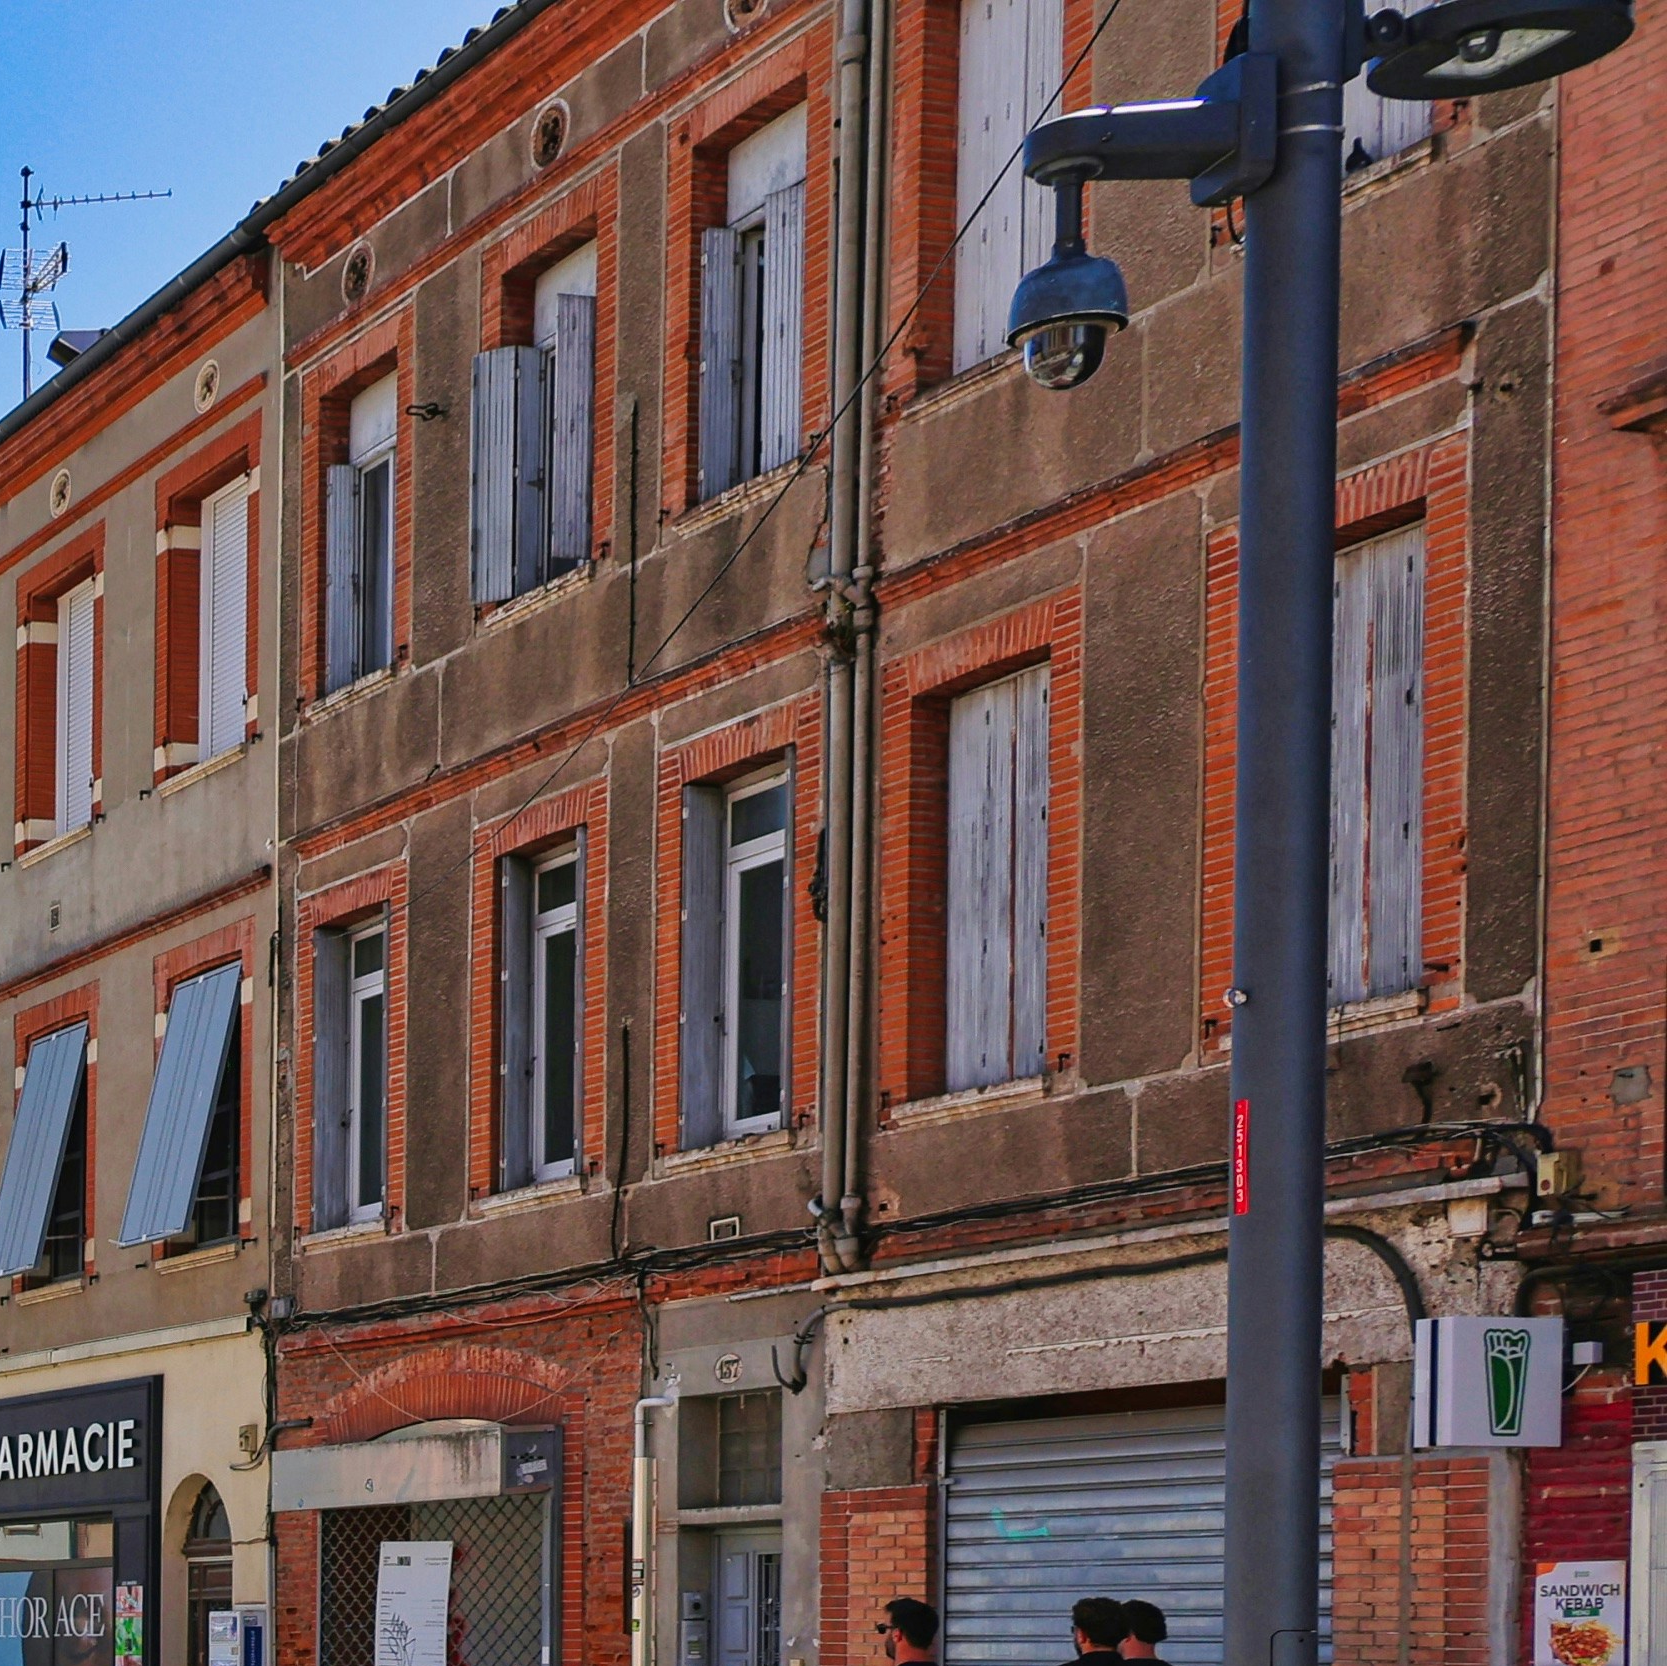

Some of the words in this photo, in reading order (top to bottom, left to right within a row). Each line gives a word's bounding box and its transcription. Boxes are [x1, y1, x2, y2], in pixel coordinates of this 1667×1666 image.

[1235, 1114, 1245, 1203] 251303
[1540, 1583, 1621, 1598] SANDWICH
[1555, 1597, 1605, 1611] KEBAB
